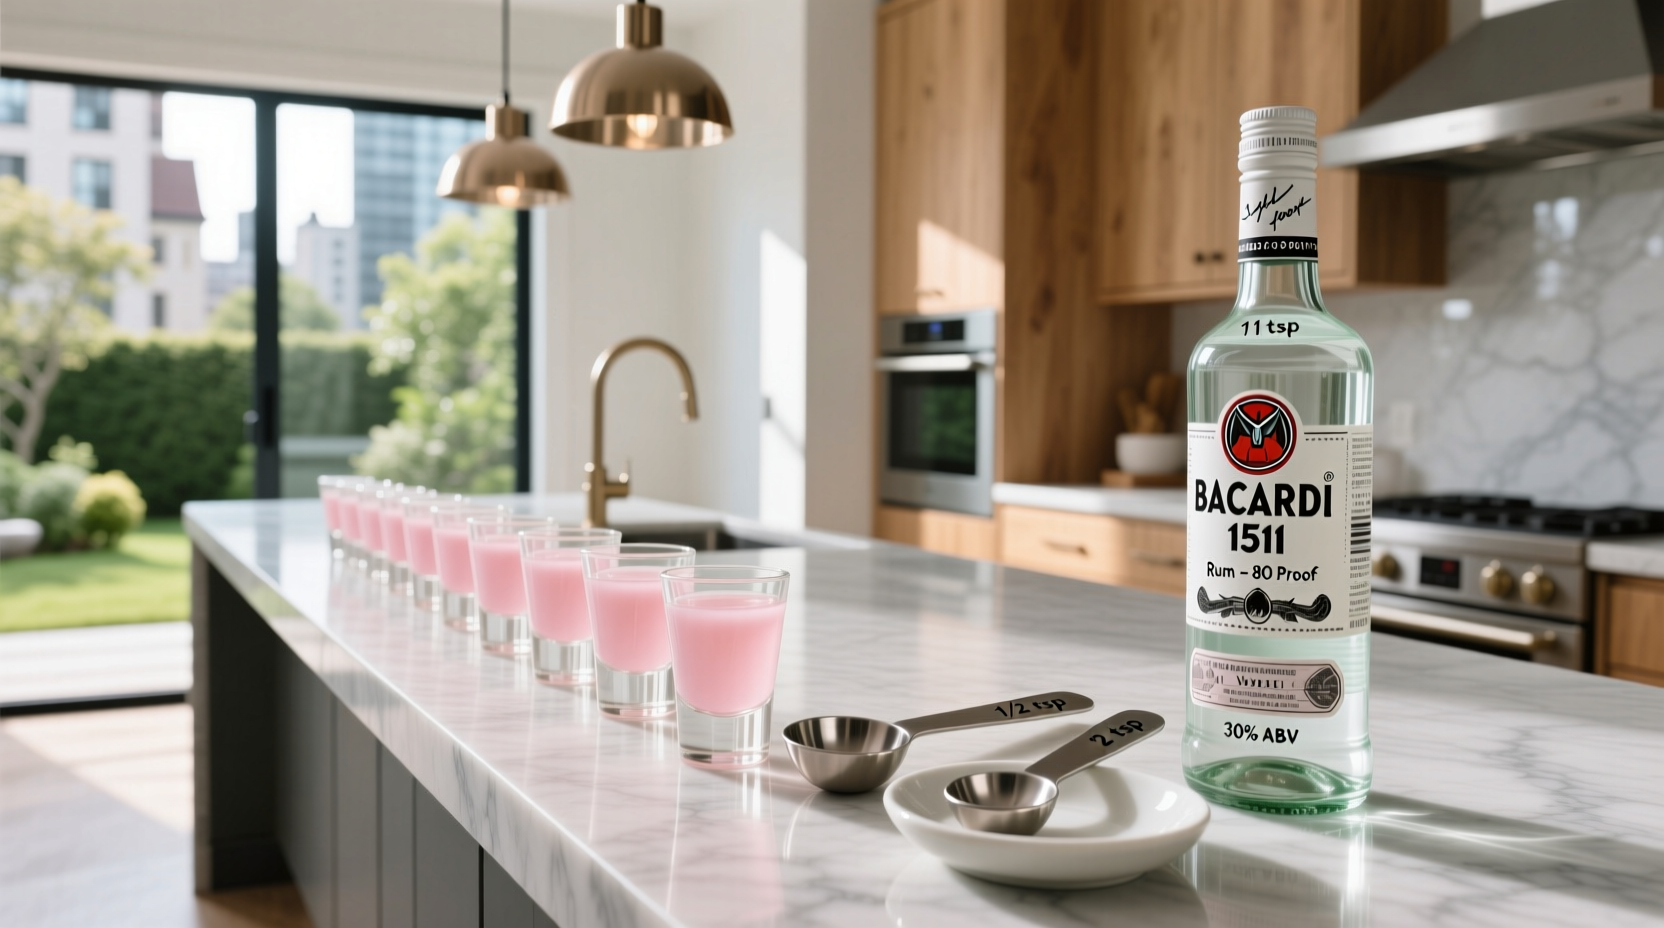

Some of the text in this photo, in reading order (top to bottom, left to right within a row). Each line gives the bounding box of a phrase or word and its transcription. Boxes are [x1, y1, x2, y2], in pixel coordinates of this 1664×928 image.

[1241, 319, 1300, 337] 11 tsp
[1228, 522, 1285, 554] 1511
[1207, 561, 1235, 579] Rum
[1252, 565, 1273, 580] 80
[1276, 566, 1319, 582] Proof
[995, 698, 1067, 719] 1/2 tsp
[1109, 720, 1144, 737] tsp
[1223, 721, 1299, 744] 30% ABV
